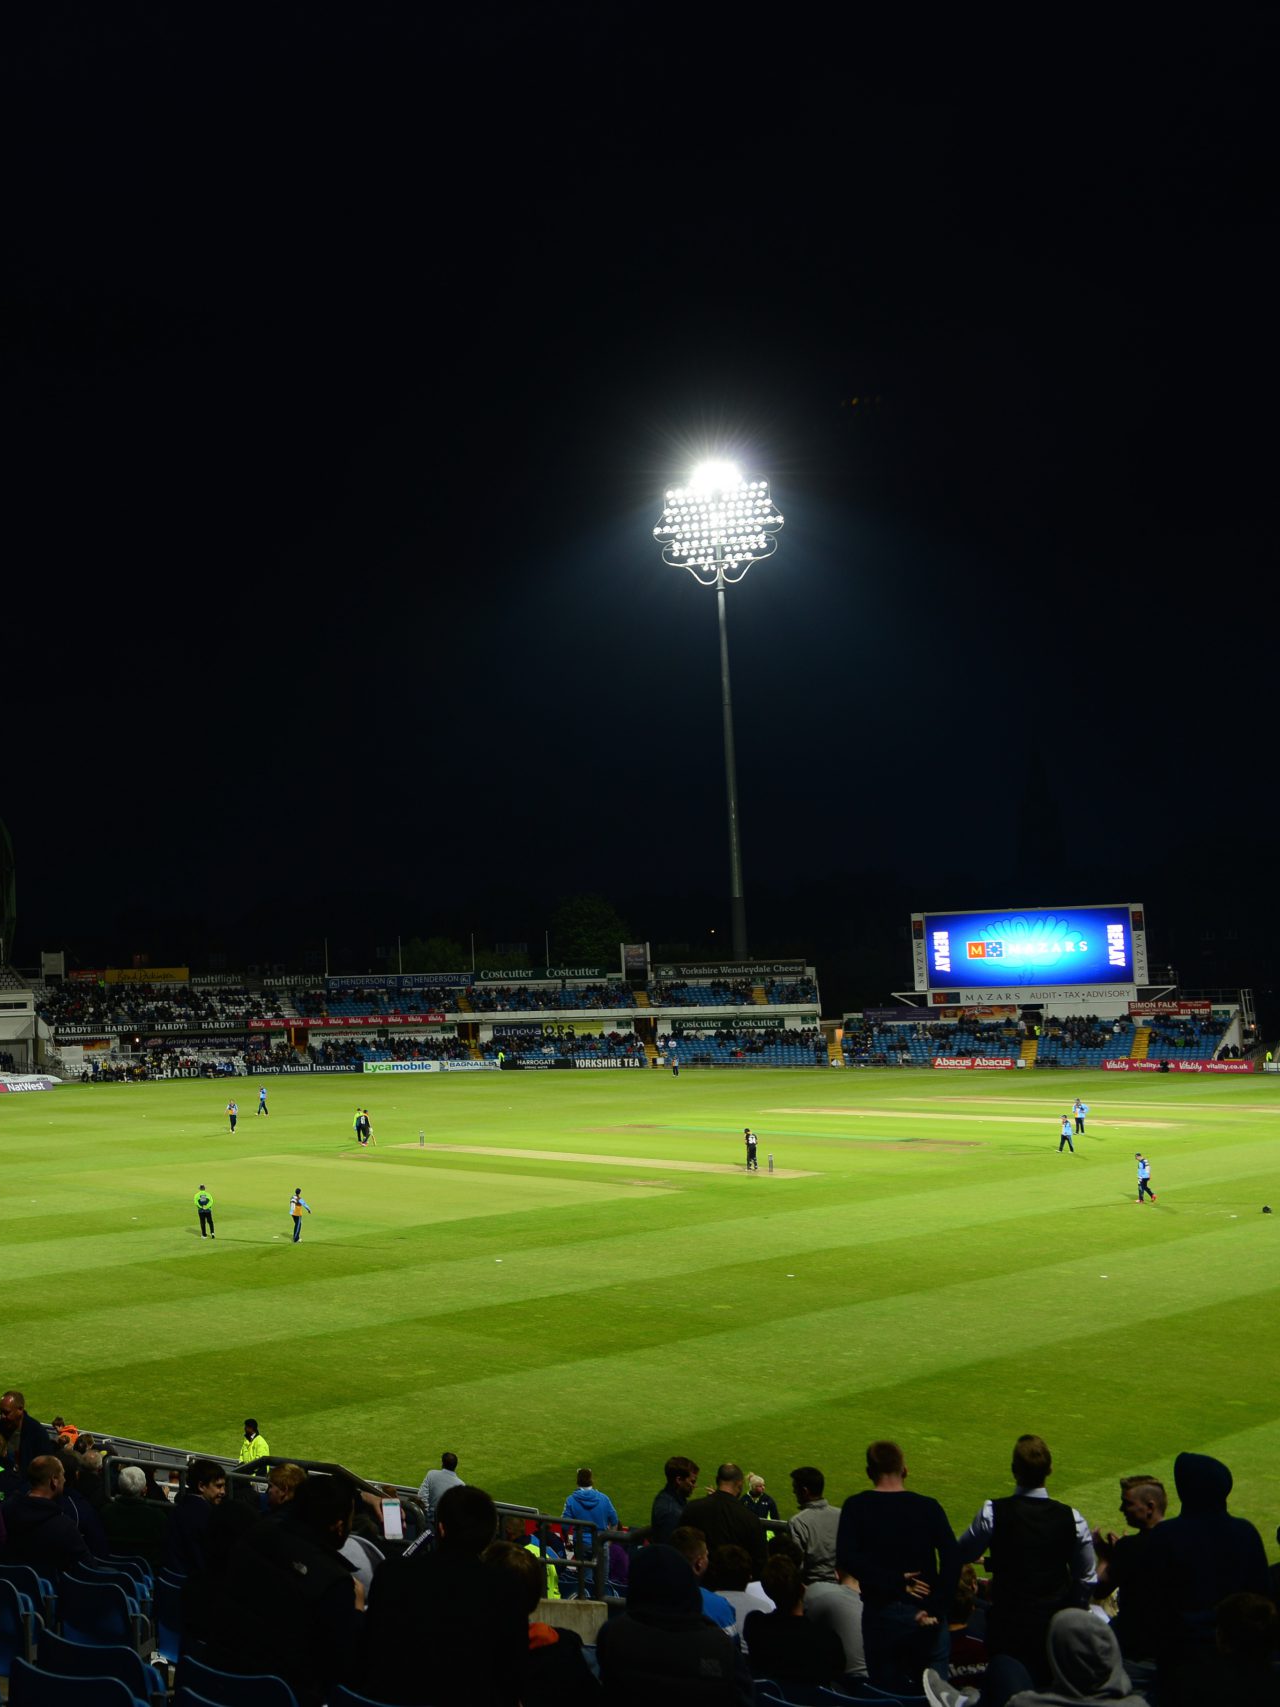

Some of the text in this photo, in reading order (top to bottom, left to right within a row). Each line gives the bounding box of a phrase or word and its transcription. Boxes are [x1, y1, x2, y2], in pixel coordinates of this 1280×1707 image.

[1008, 941, 1088, 955] MAZARS
[1107, 924, 1126, 967] REPLAY
[933, 931, 951, 972] REPLAY
[1135, 933, 1145, 978] MAZARS
[480, 969, 533, 980] Costcutter
[546, 967, 600, 978] Costcutter
[680, 964, 803, 975] Yorkshire Wensleydale Cheese
[192, 975, 241, 985] multiflight
[263, 975, 323, 987] multiflight
[340, 977, 386, 985] HENDERSON
[414, 975, 459, 983] HENDERSON
[965, 992, 1020, 1001] MAZARS
[1030, 991, 1056, 999] AUDIT
[1063, 991, 1081, 999] TAX
[1086, 990, 1130, 998] ADVISORY
[675, 1020, 721, 1028] Costcutter
[731, 1019, 780, 1028] Costcutter
[494, 1026, 541, 1036] Clinova
[364, 1061, 431, 1072] Lycamobile
[575, 1058, 640, 1068] YORKSHIRE TEA
[935, 1058, 971, 1066] Abacus
[974, 1058, 1011, 1066] Abacus
[1106, 1060, 1129, 1070] Vitality
[1179, 1061, 1202, 1072] Vitality
[163, 1067, 199, 1078] HARD
[252, 1063, 356, 1073] Liberty Mutual Insurance
[6, 1081, 46, 1092] NatWest
